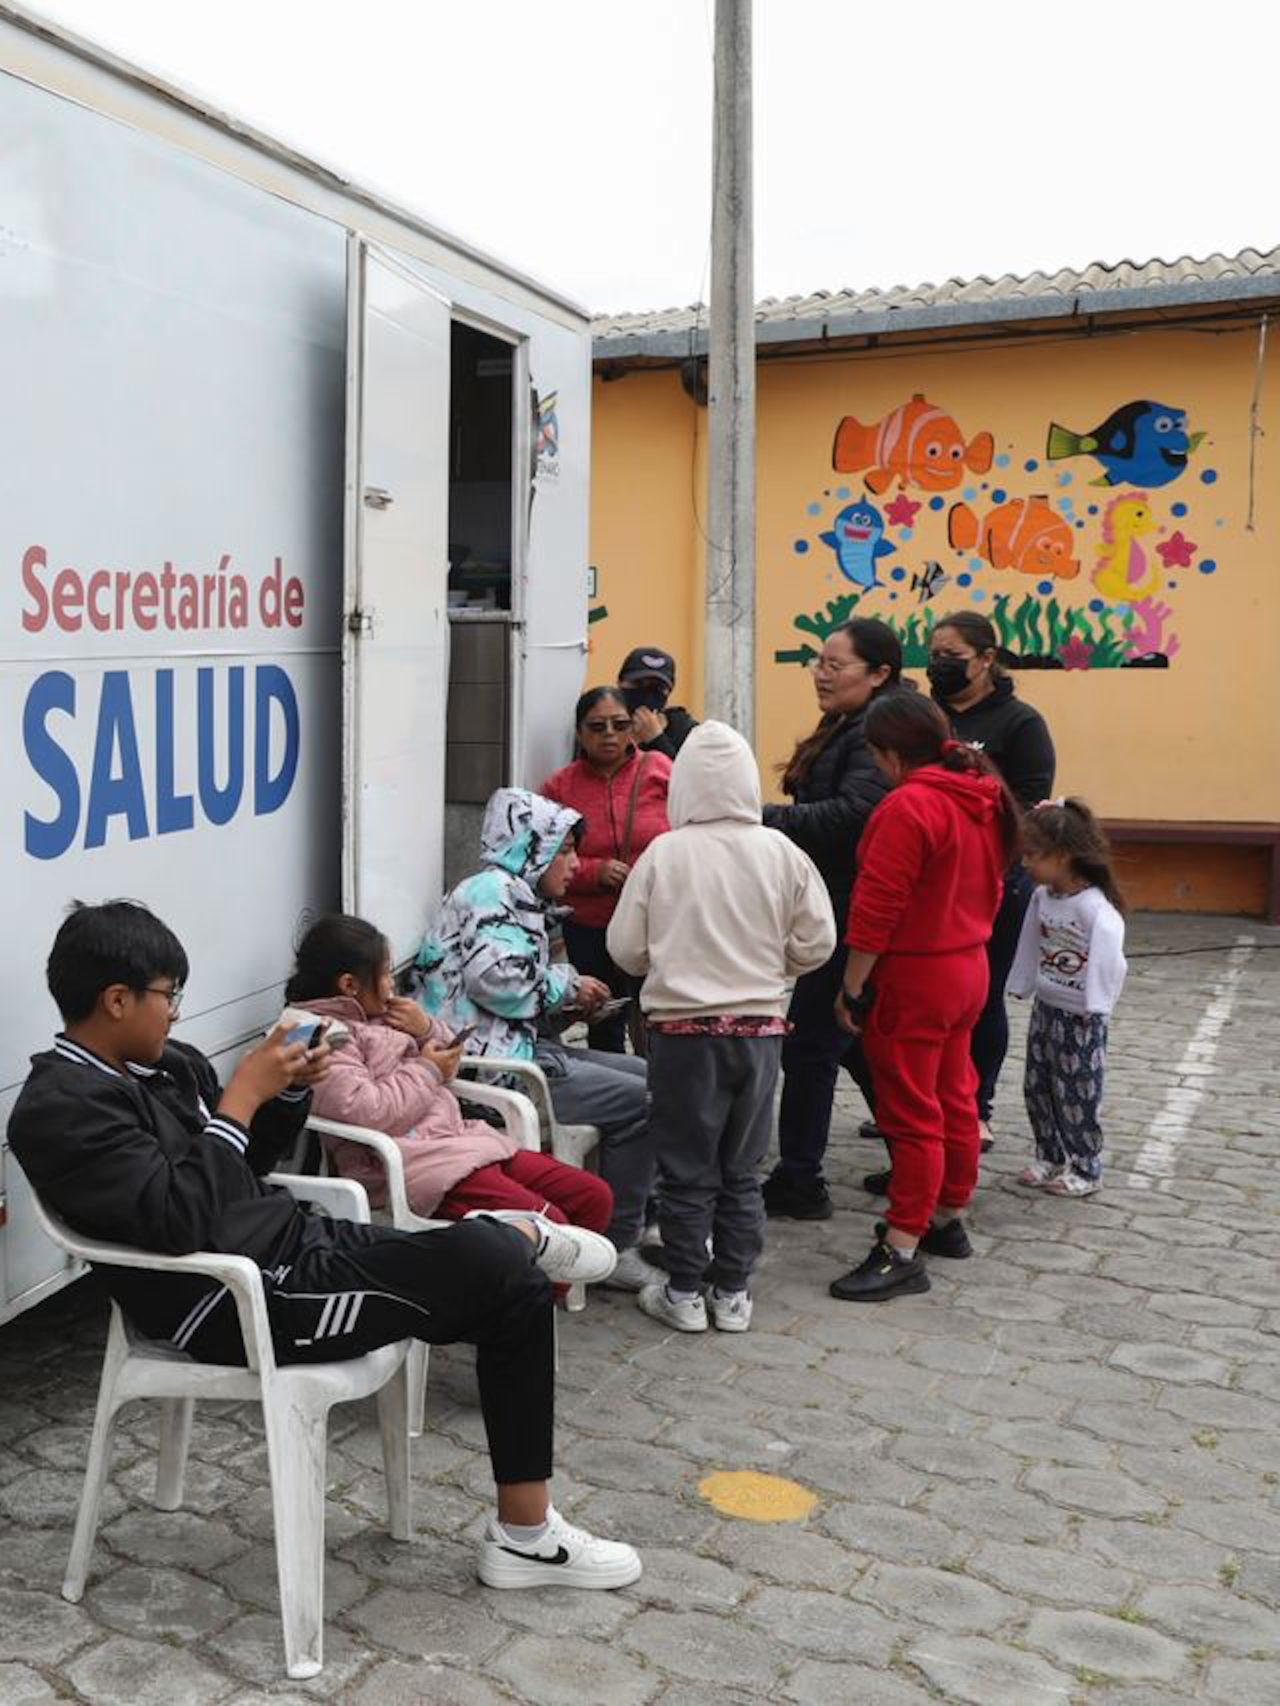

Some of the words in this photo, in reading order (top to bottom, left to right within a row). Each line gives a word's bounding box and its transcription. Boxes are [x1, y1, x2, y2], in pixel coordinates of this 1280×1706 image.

[21, 545, 249, 633] Secretaría
[258, 556, 306, 629] de
[22, 664, 301, 861] SALUD
